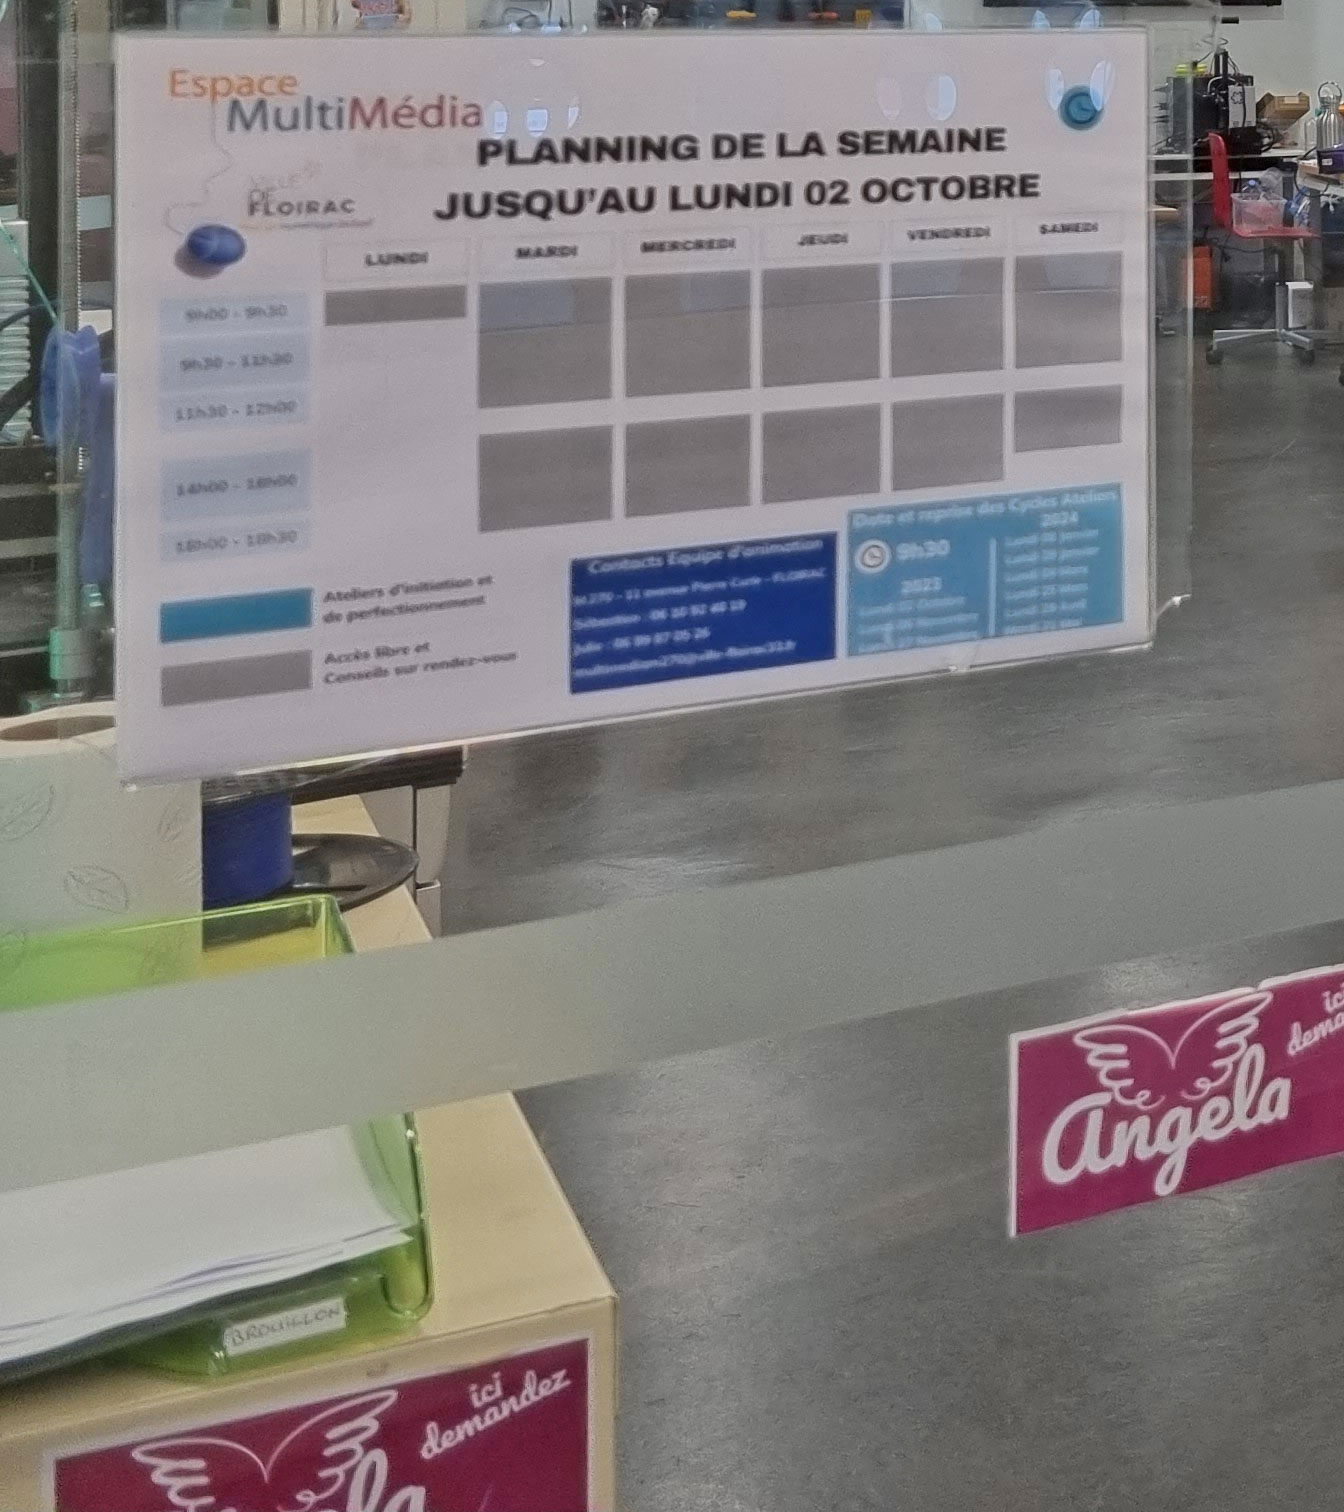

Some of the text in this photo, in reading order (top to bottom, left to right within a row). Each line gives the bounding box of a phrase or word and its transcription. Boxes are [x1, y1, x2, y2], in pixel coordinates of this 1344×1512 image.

[169, 68, 299, 102] Espace
[226, 95, 484, 135] MultiMédia
[477, 126, 1008, 168] PLANNING DE LA SEMAINE
[434, 173, 1041, 222] JUSQU'AU LUNDI 02 OCTOBRE
[247, 197, 355, 219] FLOIRAC
[1038, 221, 1099, 236] SAMEDI
[640, 237, 736, 254] MERCREDI
[798, 232, 848, 247] JEUDI
[365, 251, 429, 268] LUNDI
[515, 244, 578, 260] MARDI
[477, 574, 493, 587] et
[323, 609, 343, 623] de
[415, 641, 430, 654] et
[395, 665, 418, 677] sur
[228, 1305, 342, 1348] BROUILLON
[470, 1372, 502, 1408] ici
[420, 1368, 570, 1460] demandez
